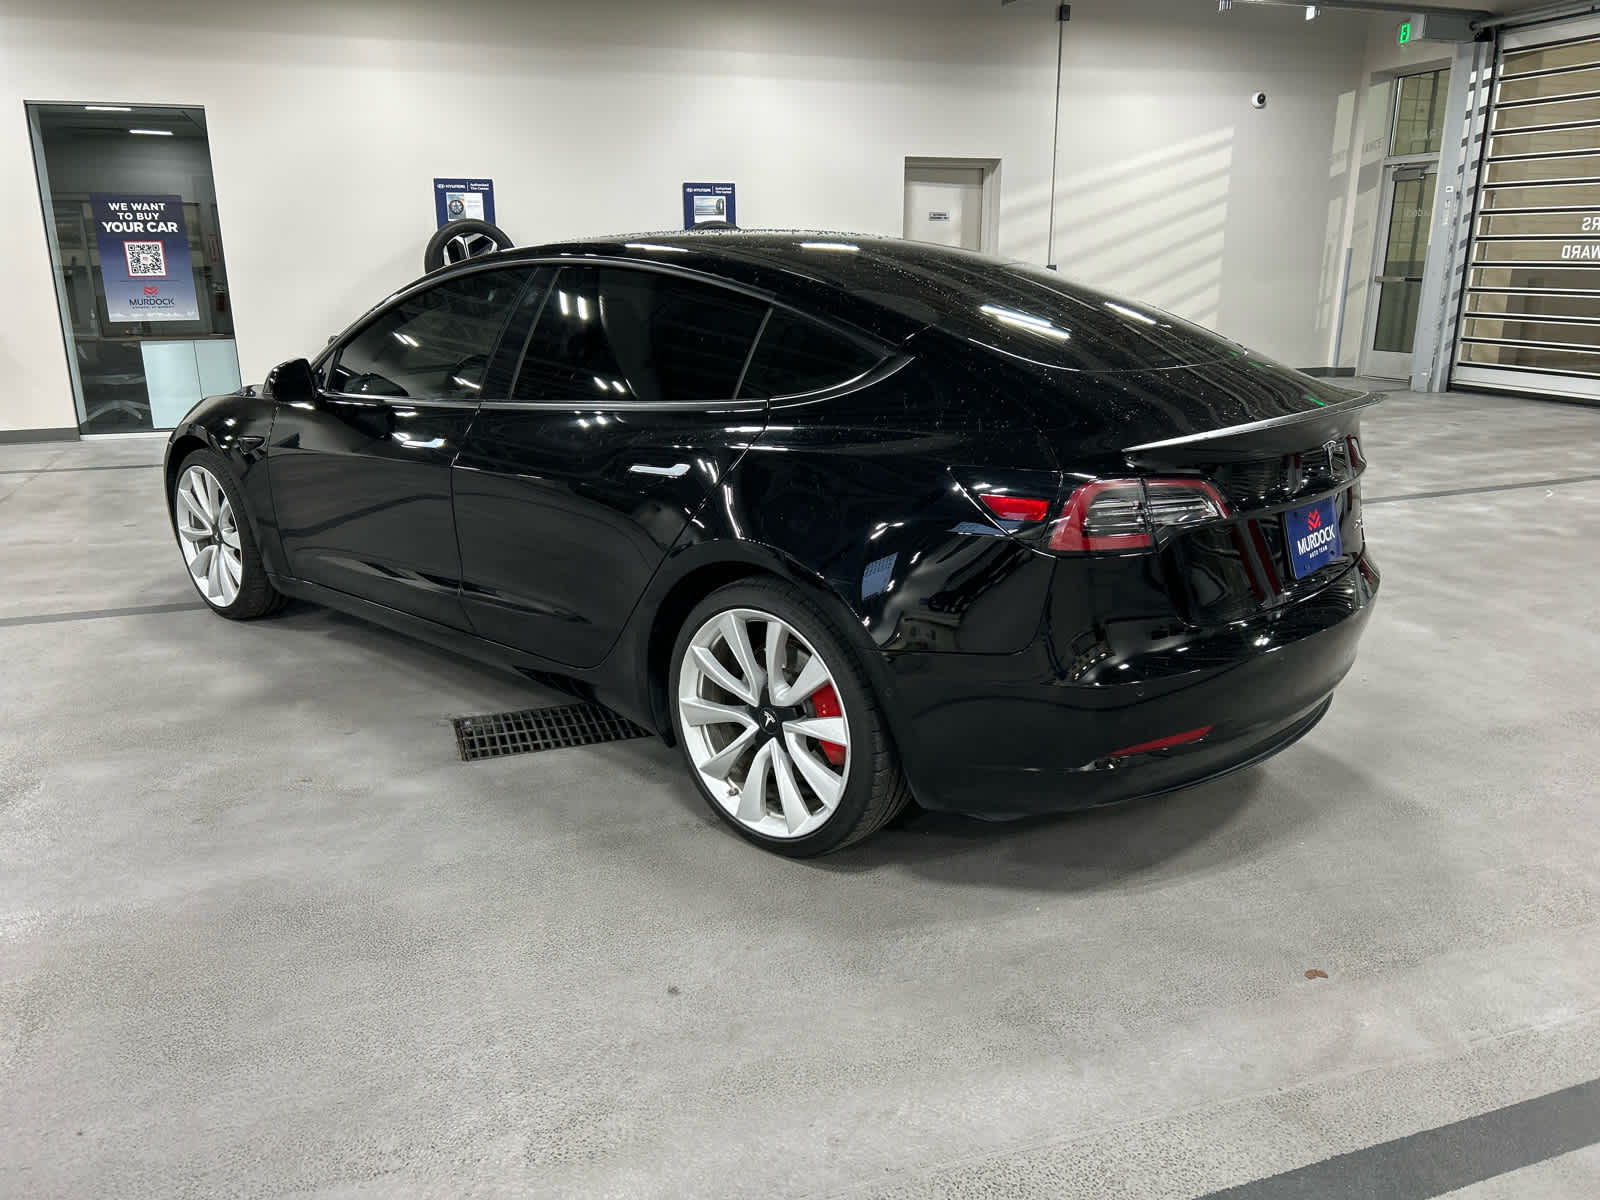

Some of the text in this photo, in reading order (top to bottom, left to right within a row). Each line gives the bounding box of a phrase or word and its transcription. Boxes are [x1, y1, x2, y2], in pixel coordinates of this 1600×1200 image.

[108, 202, 166, 211] WE WANT
[117, 212, 160, 220] TO BUY
[102, 221, 179, 233] YOUR CAR
[129, 298, 175, 306] MURDOCK
[1297, 524, 1335, 555] MURDOCK
